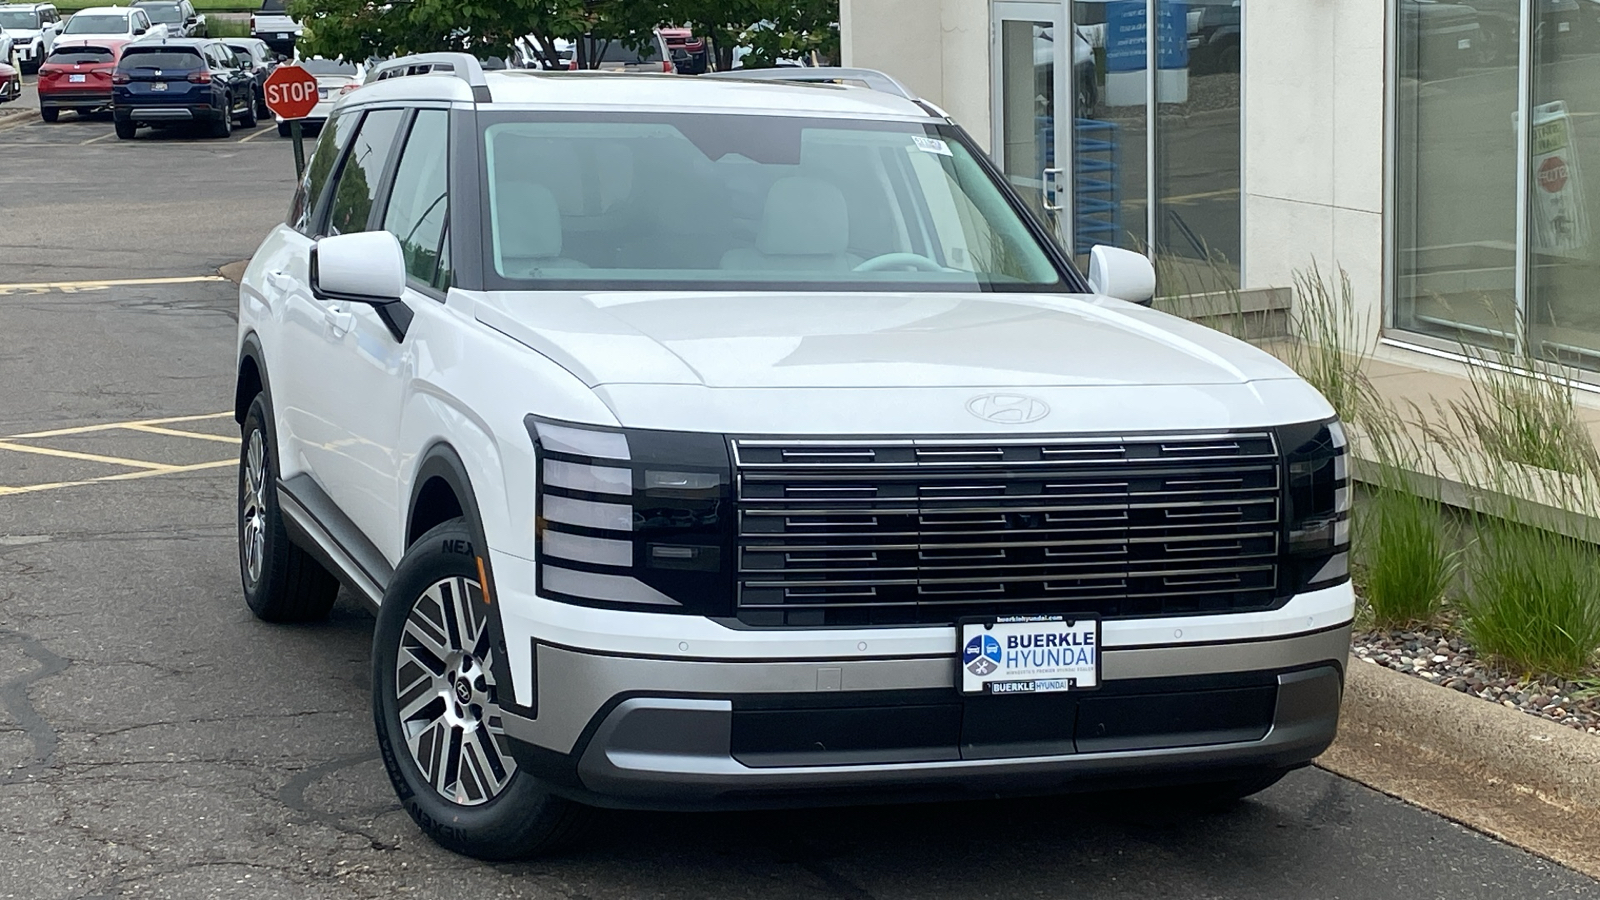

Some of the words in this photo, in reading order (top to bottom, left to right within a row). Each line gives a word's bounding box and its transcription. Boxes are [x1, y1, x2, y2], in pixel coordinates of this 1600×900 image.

[268, 81, 315, 104] STOP
[1007, 632, 1094, 648] BUERKLE
[1006, 647, 1094, 668] HYUNDAI
[993, 682, 1034, 692] BUERKLE
[1036, 680, 1067, 691] HYUNDAI
[410, 800, 468, 840] NEXEN
